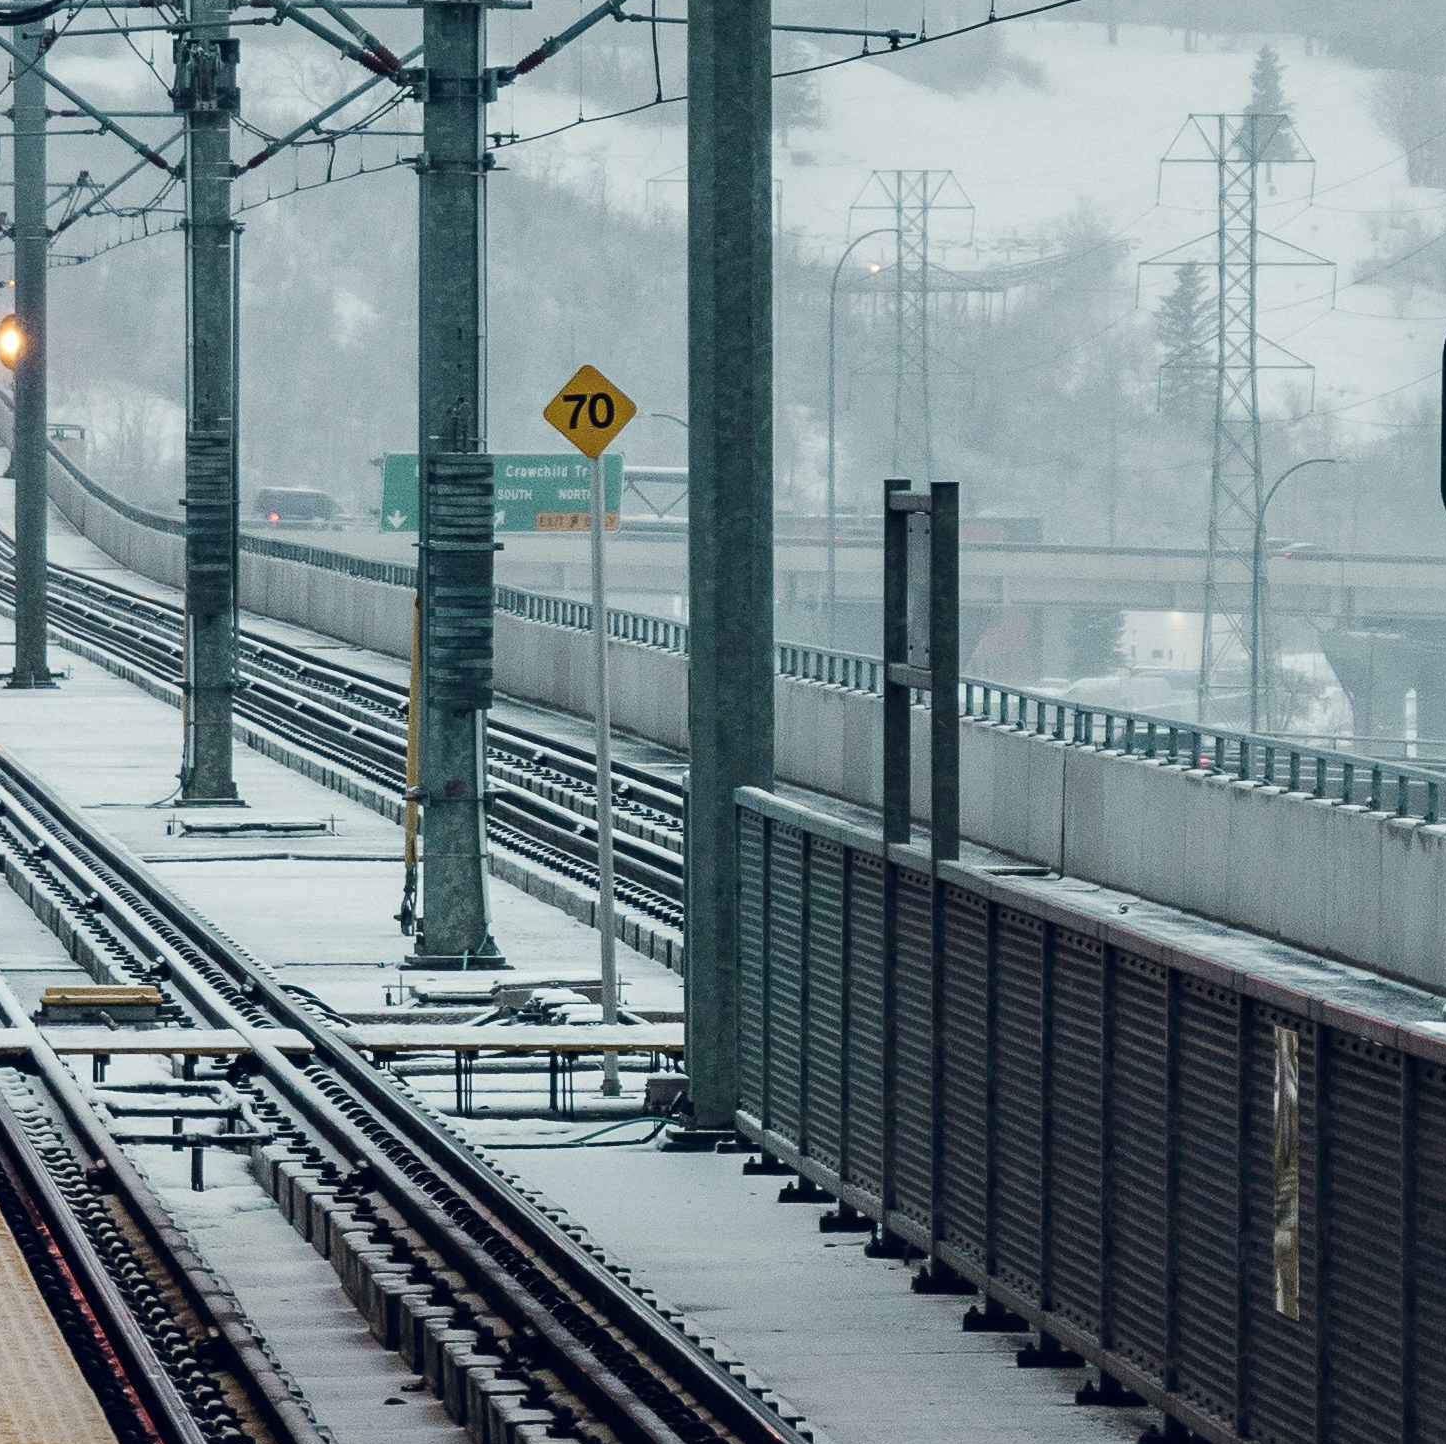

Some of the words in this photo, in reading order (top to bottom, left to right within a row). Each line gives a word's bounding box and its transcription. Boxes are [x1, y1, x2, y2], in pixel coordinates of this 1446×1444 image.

[562, 392, 615, 430] 70
[504, 464, 569, 478] Crowchild
[497, 488, 533, 501] SOUTH
